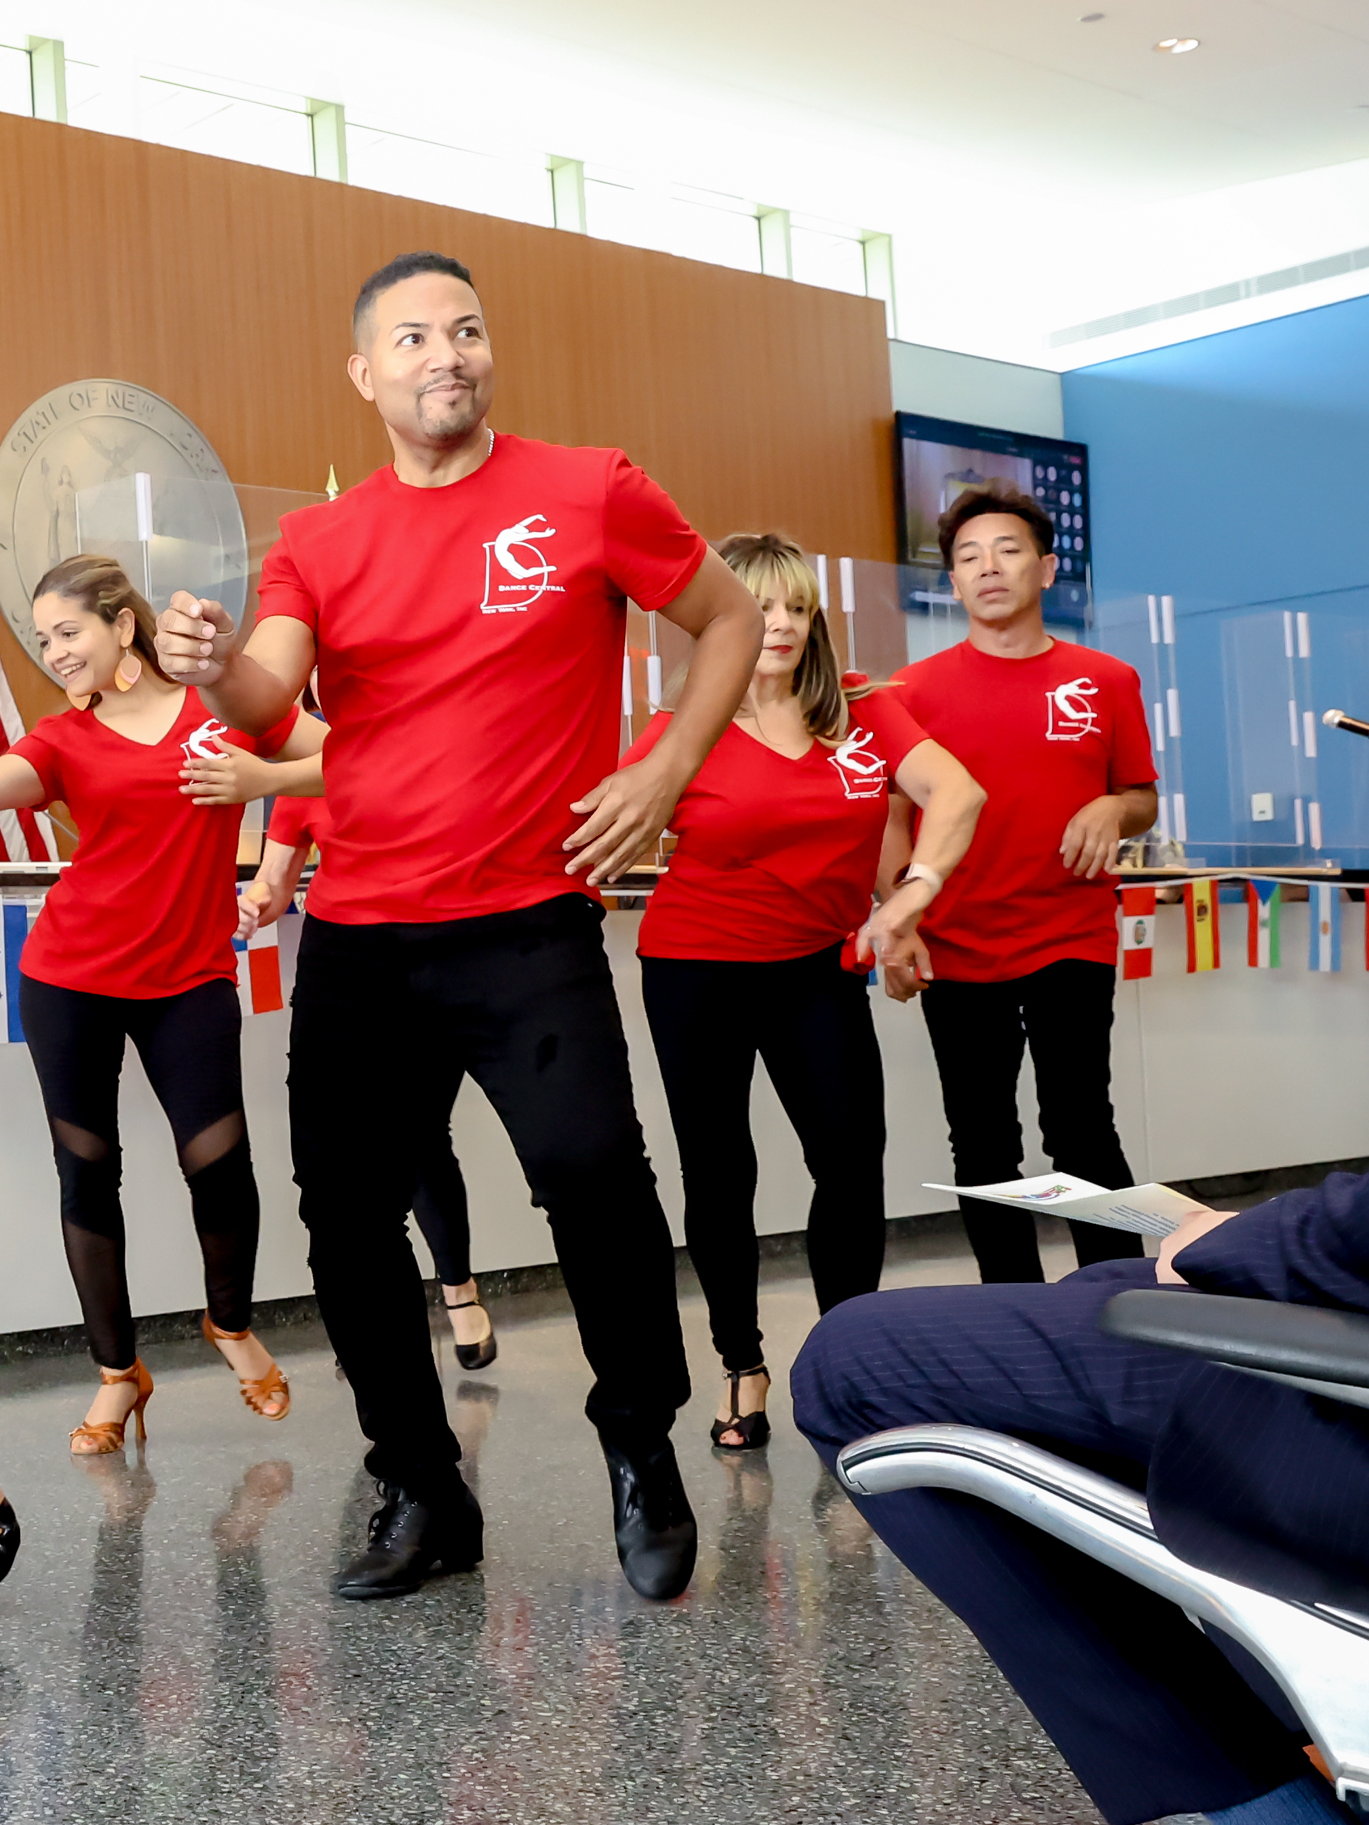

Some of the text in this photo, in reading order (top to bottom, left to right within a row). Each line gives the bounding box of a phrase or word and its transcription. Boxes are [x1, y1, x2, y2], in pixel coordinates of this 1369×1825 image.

[68, 388, 98, 411] OF
[105, 387, 156, 421] NEW
[528, 584, 567, 592] CENTRAL
